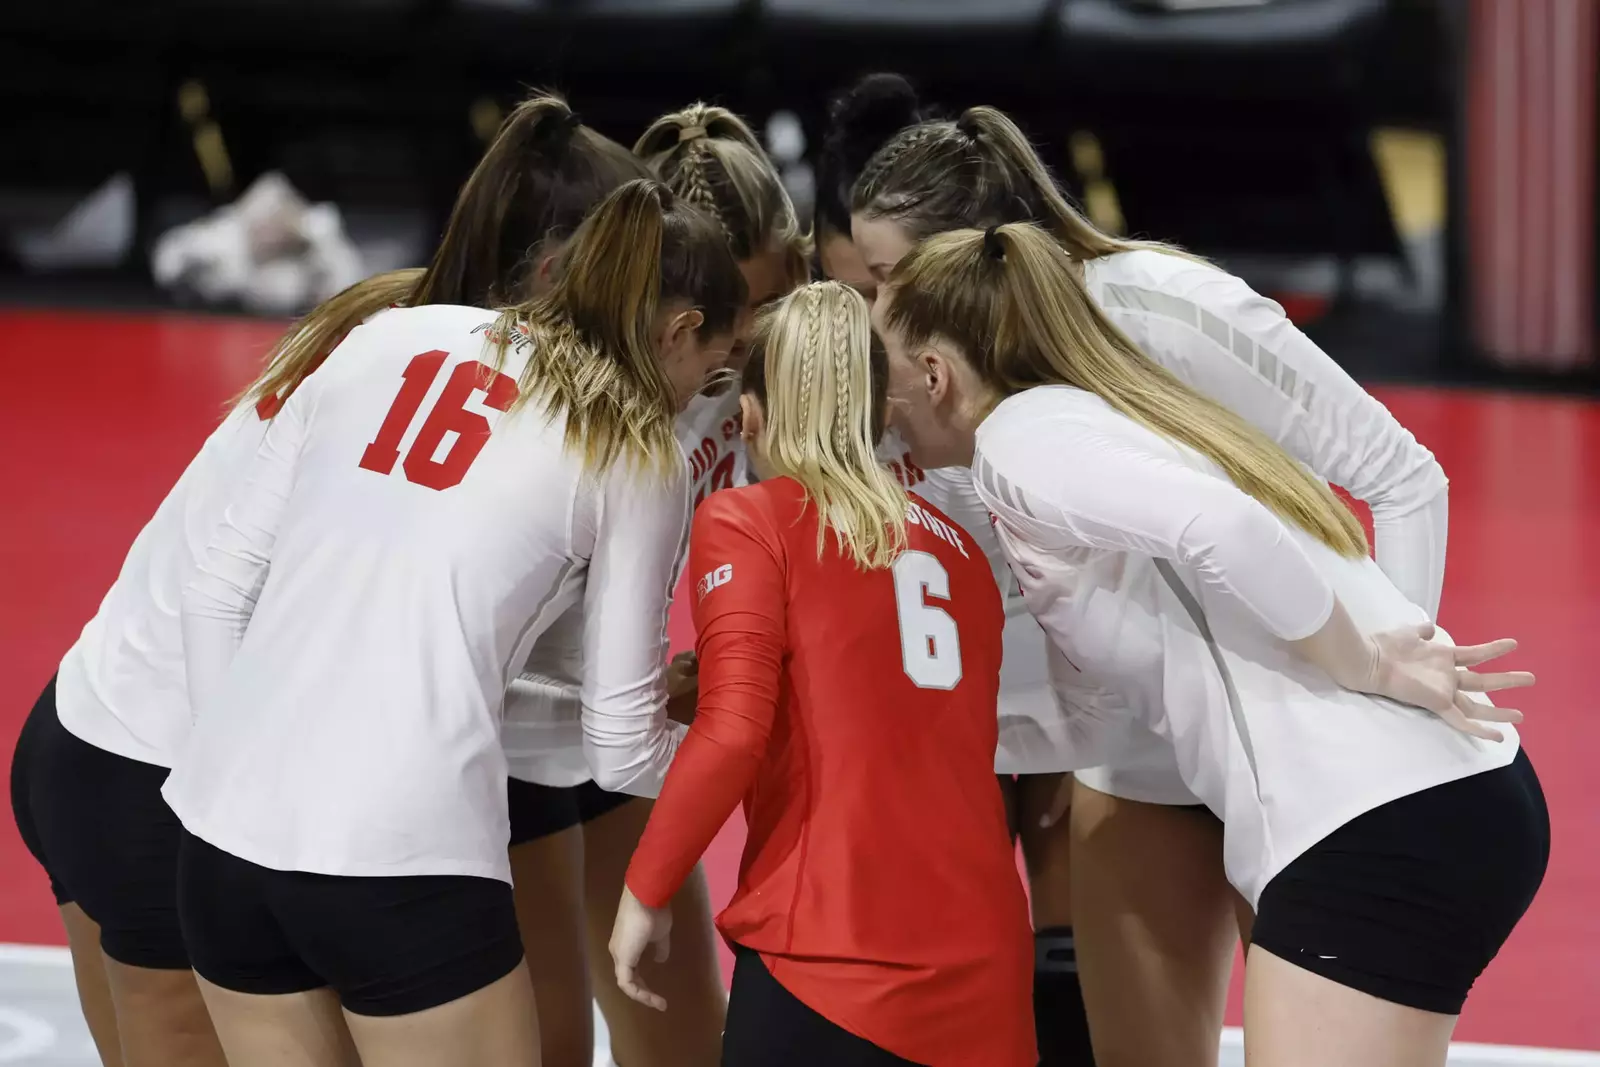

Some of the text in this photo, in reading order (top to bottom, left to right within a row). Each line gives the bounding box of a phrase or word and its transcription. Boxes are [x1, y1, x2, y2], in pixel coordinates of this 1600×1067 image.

[358, 349, 520, 491] 16
[905, 501, 970, 560] STATE
[892, 551, 963, 691] 6
